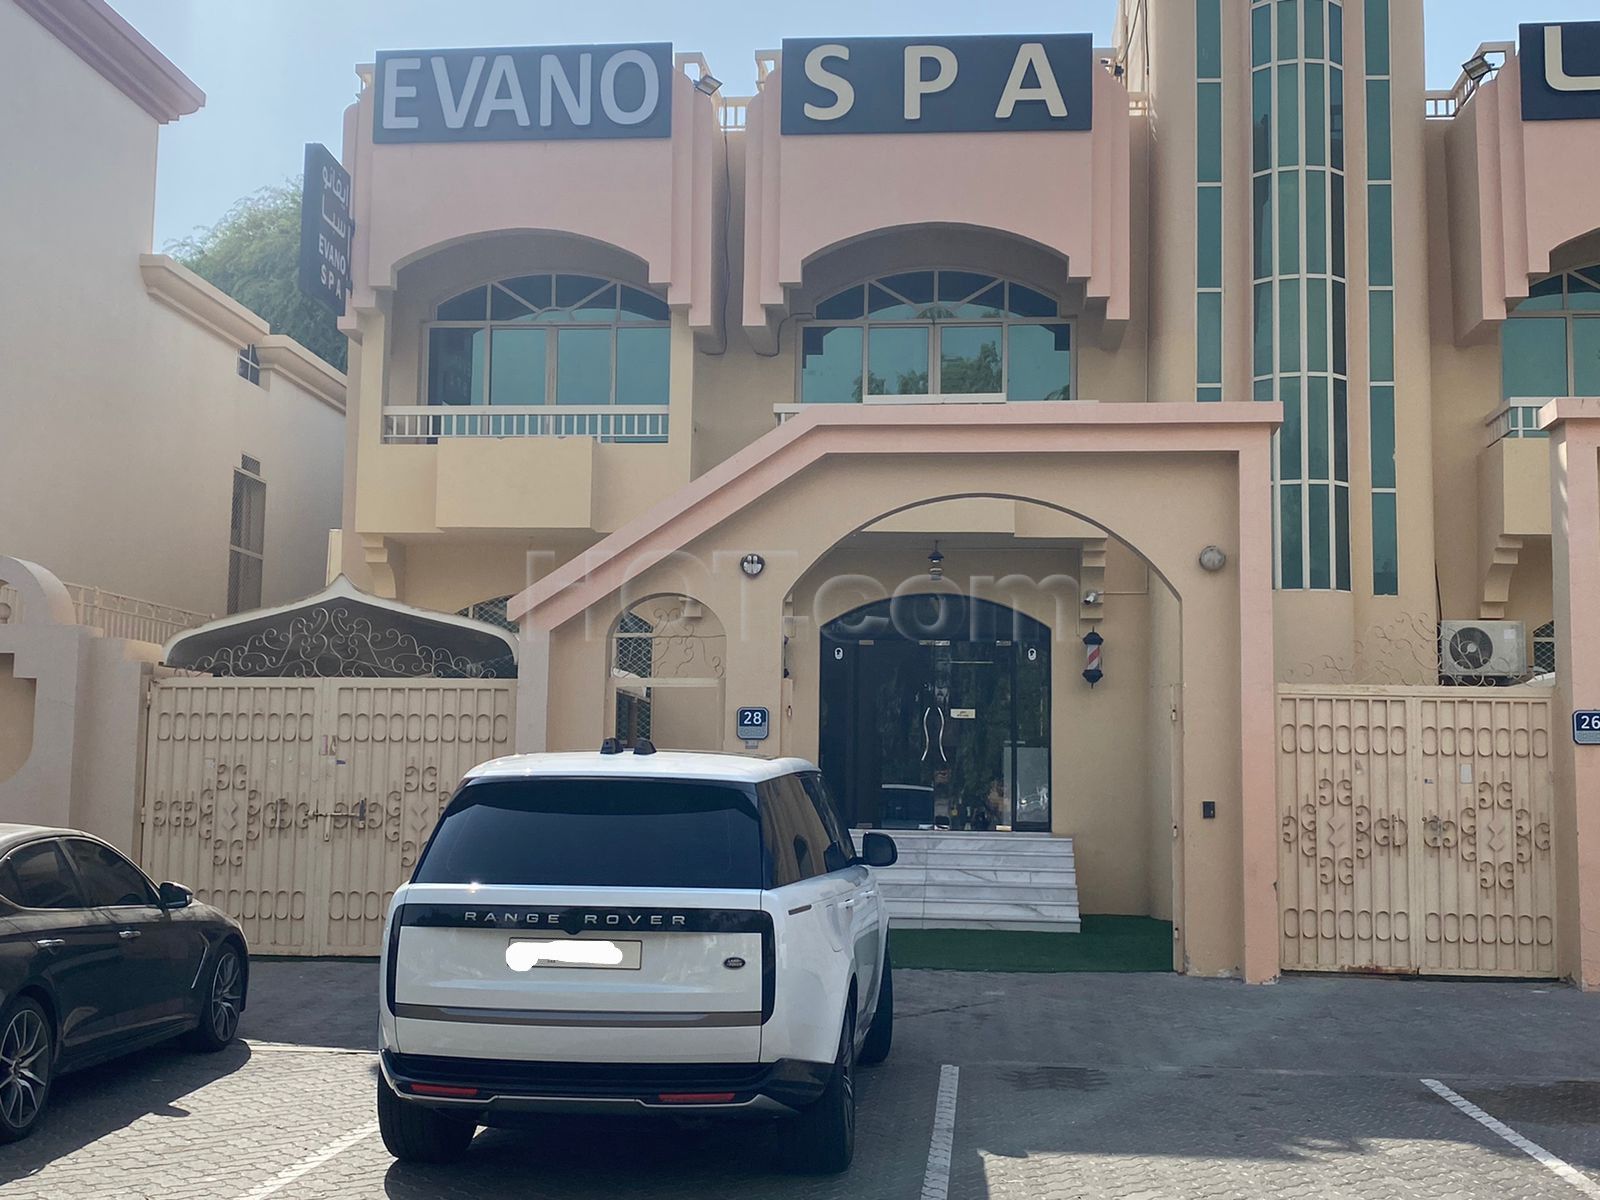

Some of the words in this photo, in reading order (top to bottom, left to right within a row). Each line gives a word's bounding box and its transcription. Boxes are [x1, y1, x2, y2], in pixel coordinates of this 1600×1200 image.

[382, 49, 660, 130] EVANO
[803, 42, 1068, 121] SPA
[318, 233, 346, 276] EVANO
[320, 264, 342, 300] SPA
[743, 711, 762, 725] 28
[1581, 715, 1600, 729] 26
[464, 911, 560, 924] RANGE
[584, 914, 686, 926] ROVER
